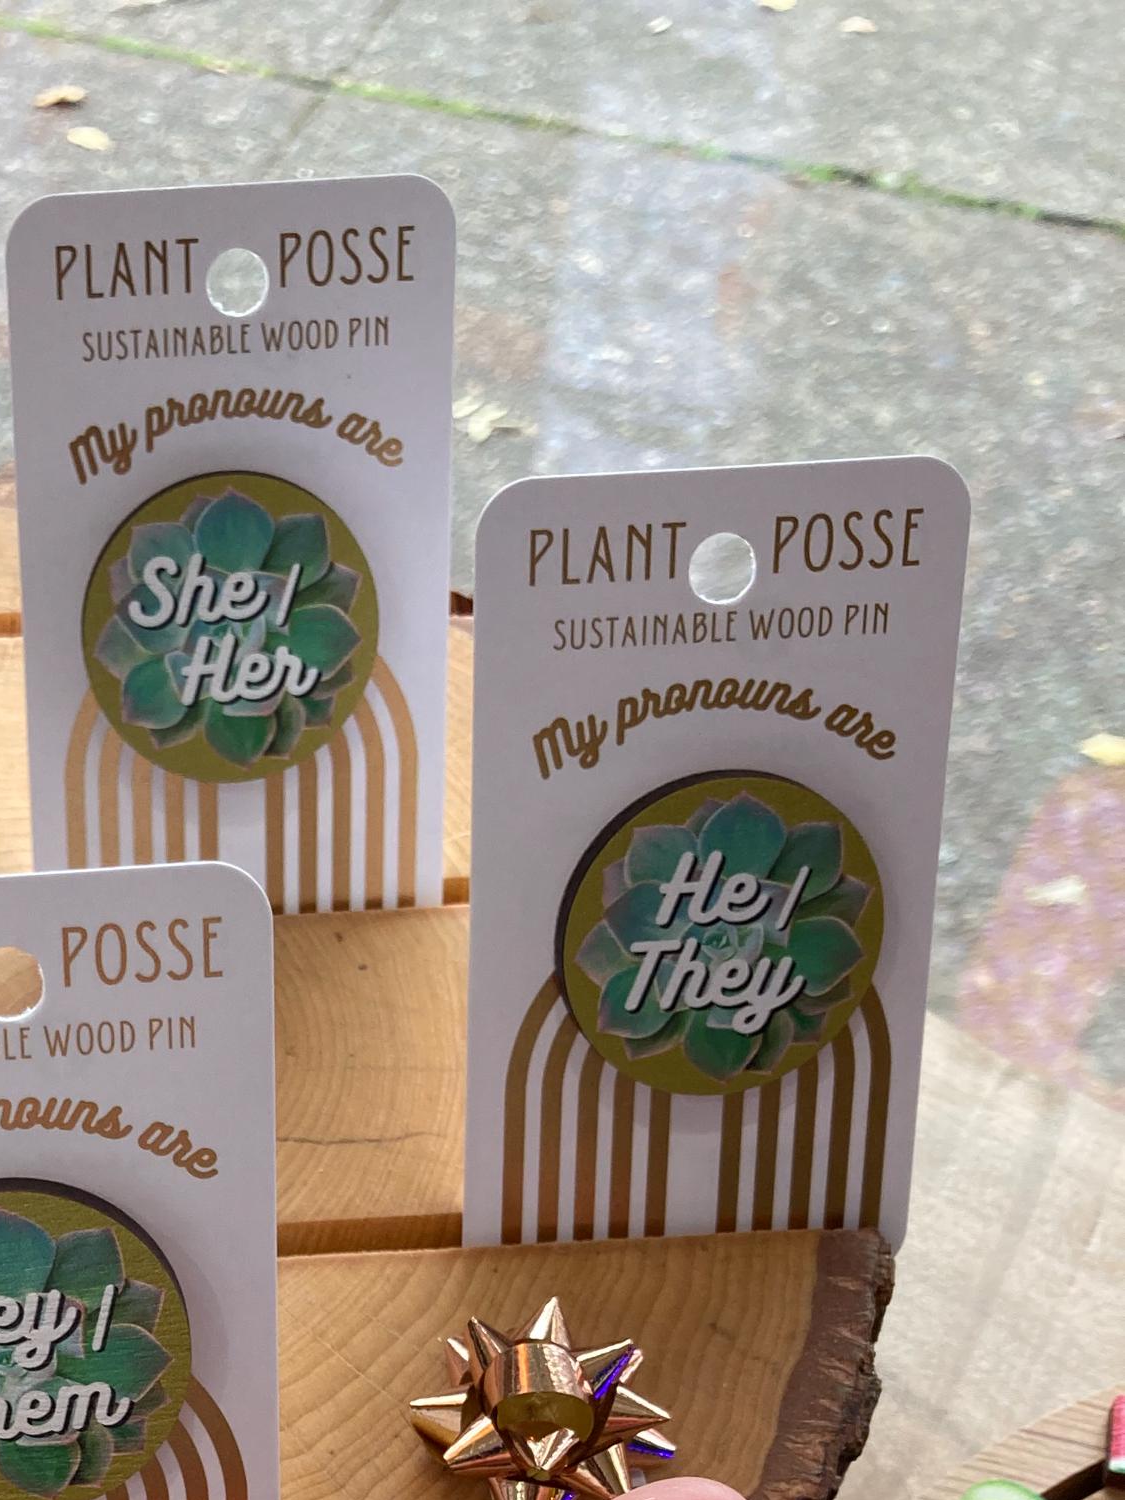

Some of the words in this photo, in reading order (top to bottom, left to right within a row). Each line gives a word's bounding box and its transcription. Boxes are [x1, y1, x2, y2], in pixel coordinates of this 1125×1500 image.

[55, 238, 199, 300] PLANT
[279, 225, 415, 288] POSSE
[82, 325, 251, 362] SUSTAINABLE
[261, 320, 338, 353] WOOD
[349, 316, 389, 347] PIN
[69, 424, 137, 485] My
[145, 387, 332, 452] pronouns
[337, 414, 404, 467] are
[528, 522, 687, 587] PLANT
[772, 508, 924, 574] POSSE
[553, 611, 737, 651] SUSTAINABLE
[749, 605, 833, 639] WOOD
[844, 602, 889, 635] PIN
[180, 630, 319, 707] Her
[533, 715, 607, 780] My
[616, 677, 821, 745] pronouns
[824, 702, 896, 760] are
[61, 916, 223, 987] POSSE
[623, 939, 806, 1034] They
[43, 1021, 135, 1057] WOOD
[149, 1016, 196, 1050] PIN
[138, 1120, 219, 1180] are
